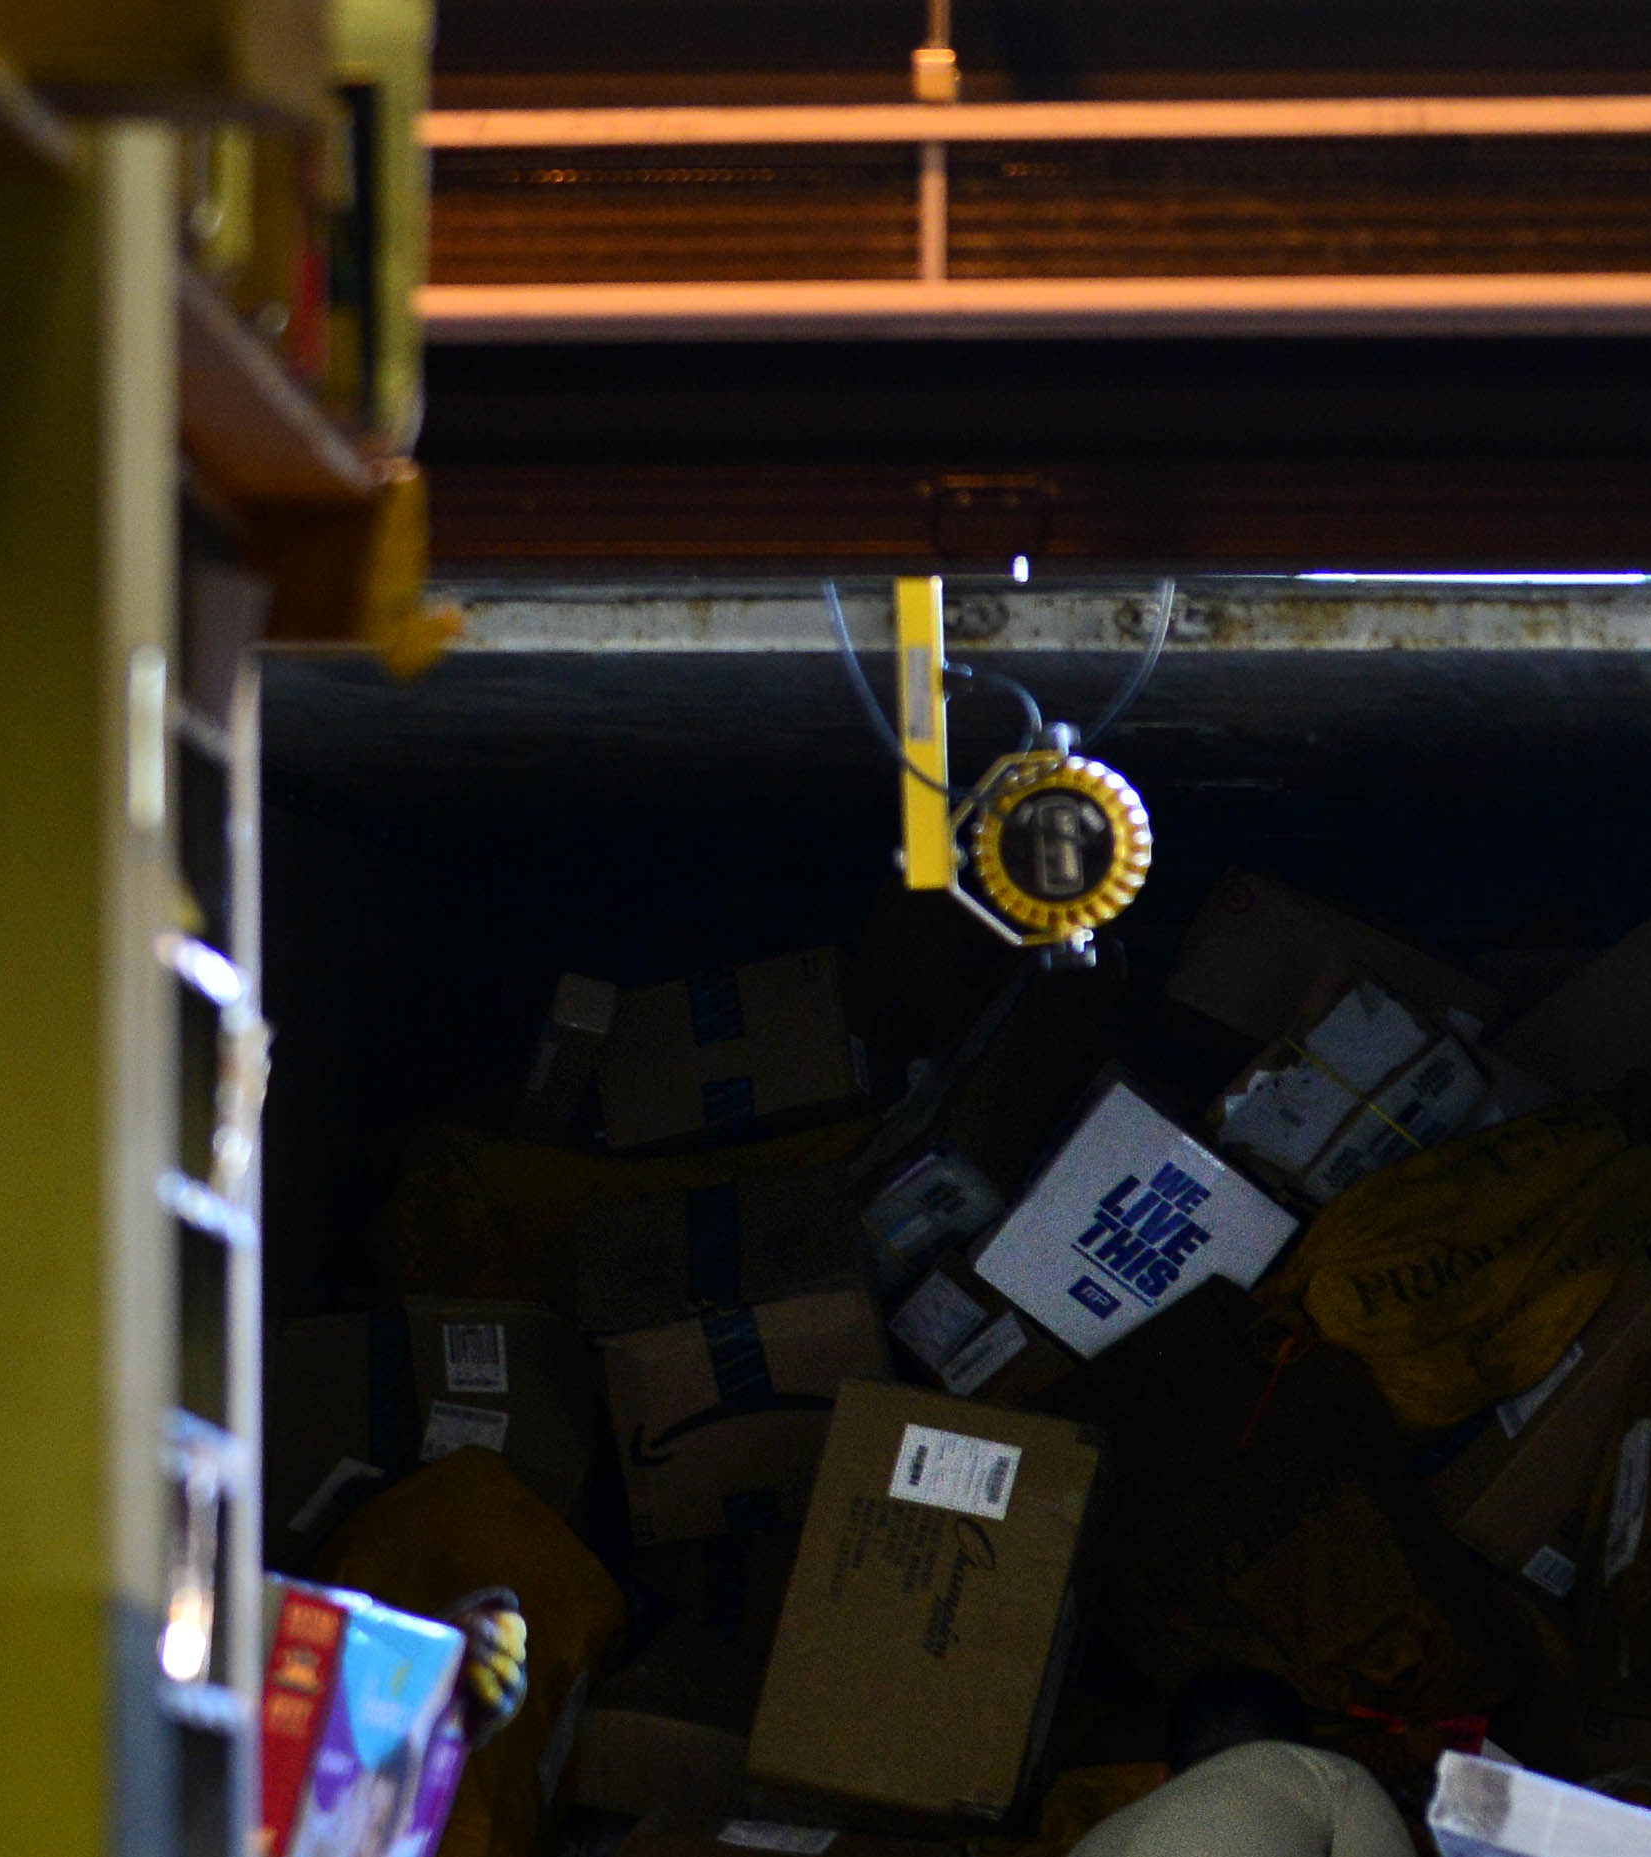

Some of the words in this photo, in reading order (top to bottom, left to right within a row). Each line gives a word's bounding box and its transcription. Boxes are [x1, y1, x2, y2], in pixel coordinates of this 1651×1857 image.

[1099, 1175, 1211, 1265] LIVE
[1151, 1162, 1210, 1214] WE
[1079, 1211, 1179, 1297] THIS
